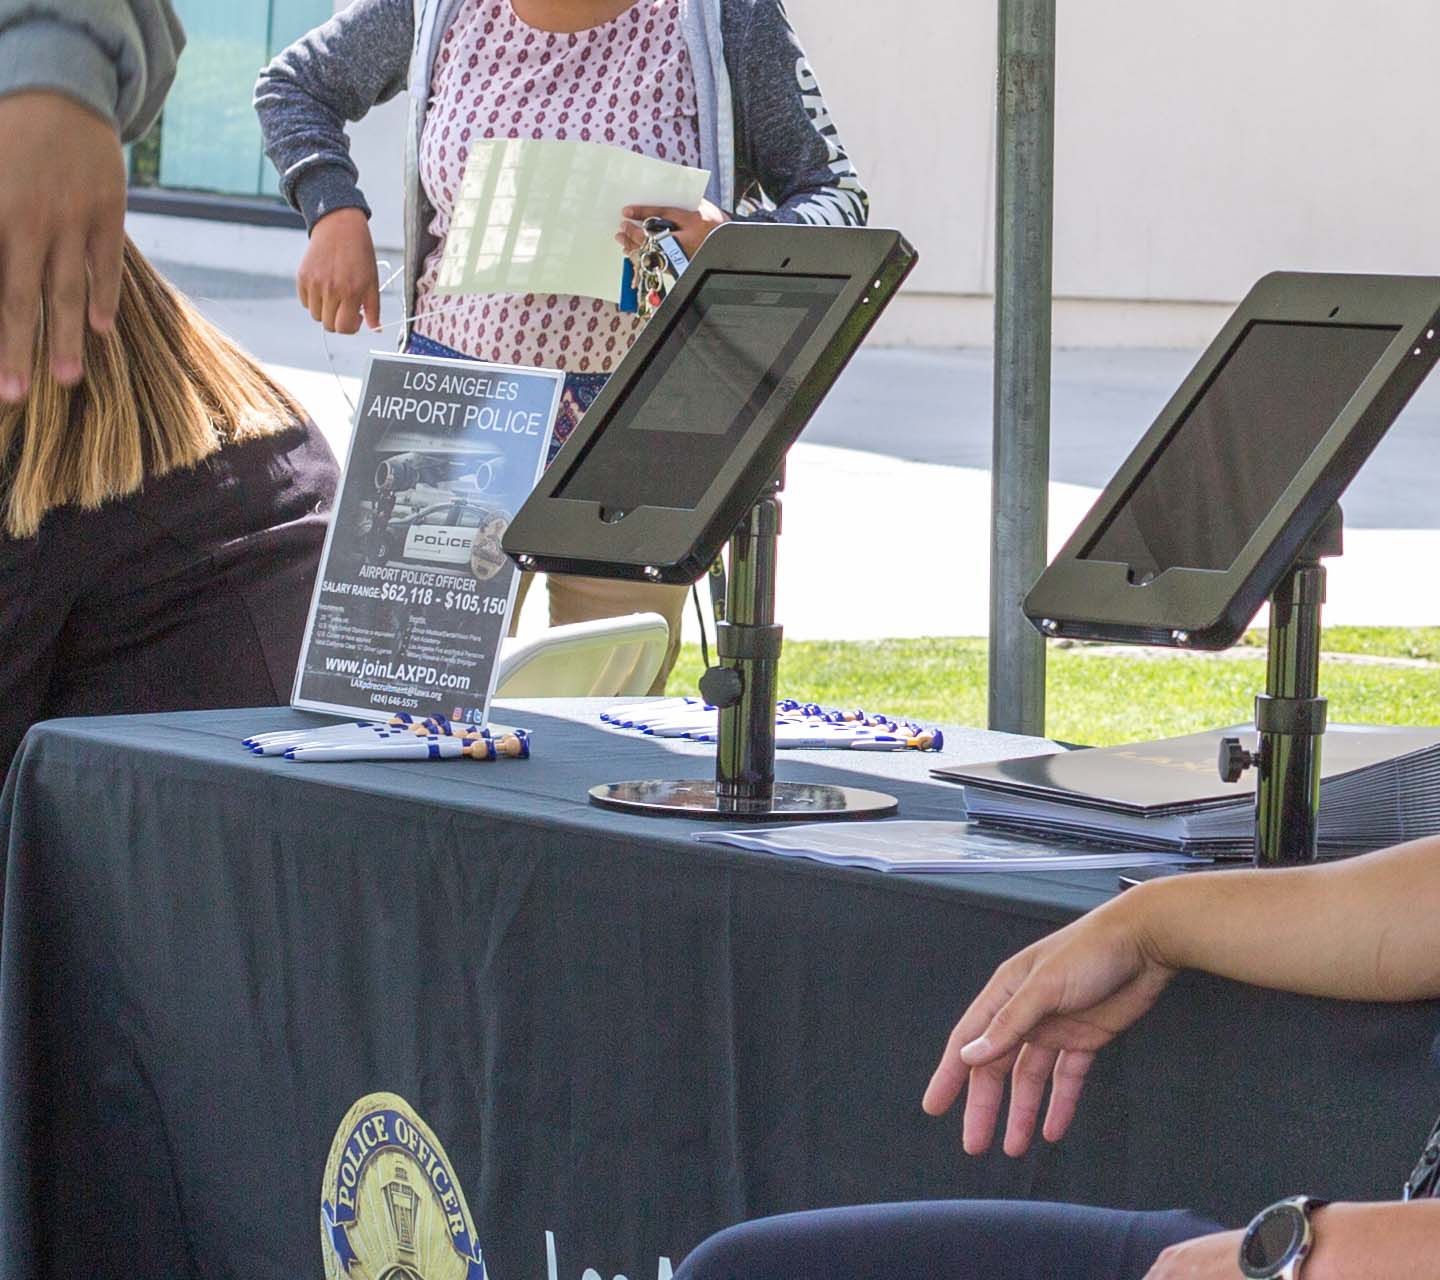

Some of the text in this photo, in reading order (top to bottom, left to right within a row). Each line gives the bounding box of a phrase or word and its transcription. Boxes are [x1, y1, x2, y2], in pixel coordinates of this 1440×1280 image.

[403, 371, 519, 401] LOS ANGELES
[367, 395, 544, 436] AIRPORT POLICE
[413, 533, 472, 549] POLICE
[358, 564, 477, 592] AIRPORT POLICE OFFICER
[321, 580, 352, 596] SALARY
[380, 582, 433, 608] $62,118
[444, 591, 506, 616] $105,150
[325, 655, 471, 690] www.joinLAXPD.com
[339, 1114, 466, 1236] POLICE OFFICER
